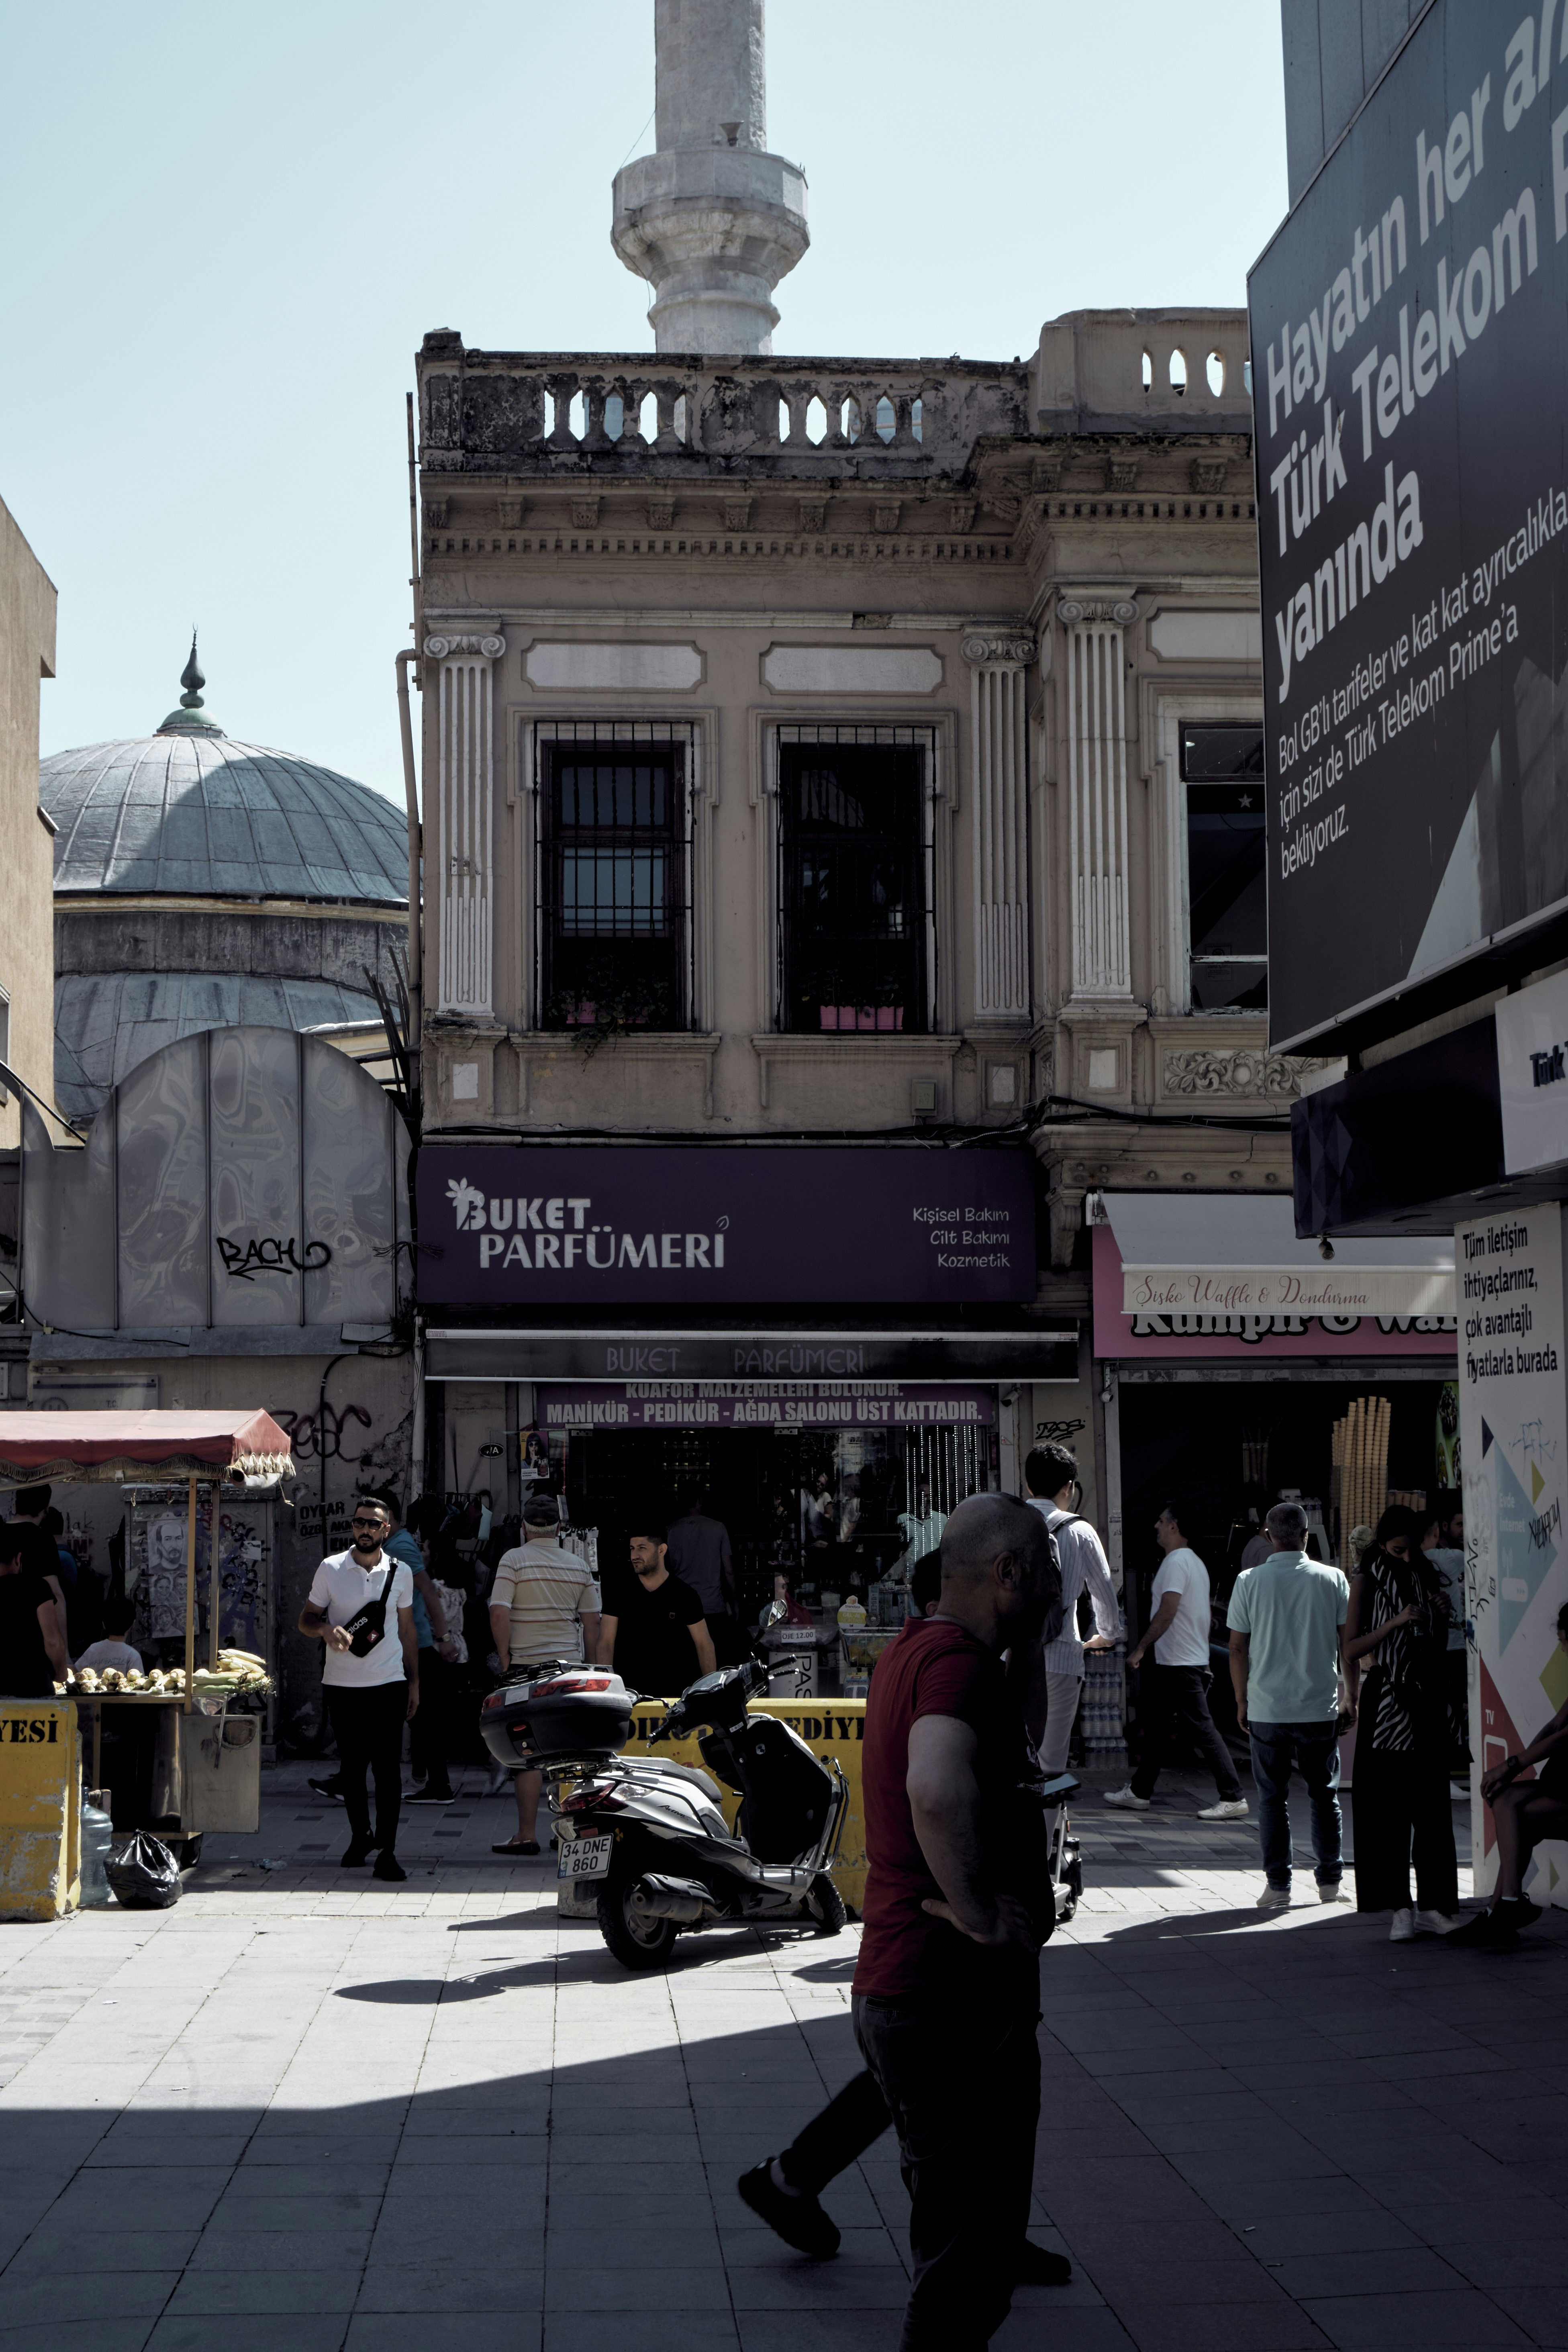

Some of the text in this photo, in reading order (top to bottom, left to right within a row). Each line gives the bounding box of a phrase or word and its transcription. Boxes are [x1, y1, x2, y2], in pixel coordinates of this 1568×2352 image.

[1267, 195, 1407, 438] Hayatın
[1416, 71, 1490, 247] her
[1270, 396, 1348, 557] Türk
[1352, 187, 1539, 463] Telekom
[1275, 460, 1424, 703] yanında
[1279, 722, 1298, 775] Bol
[1333, 653, 1387, 725] tarifeler
[1390, 634, 1408, 675] ve
[1412, 599, 1438, 657] kat
[1441, 572, 1469, 633] kat
[1280, 782, 1300, 833] için
[1303, 756, 1323, 808] sizi
[1325, 744, 1343, 788] de
[1345, 713, 1377, 771] Türk
[1378, 665, 1445, 744] Telekom
[1281, 804, 1349, 880] bekliyoruz.
[452, 1189, 591, 1230] BUKET
[913, 1207, 1009, 1224] Kişisel Bakım
[480, 1217, 728, 1268] PARFÜMERİ
[930, 1231, 1009, 1244] Cilt Bakımı
[1463, 1222, 1527, 1259] Tüm iletişim
[938, 1253, 1011, 1267] Kozmetik
[1188, 1275, 1253, 1309] Waffle
[1258, 1287, 1270, 1303] &
[1278, 1275, 1370, 1305] Dondurma
[1464, 1266, 1537, 1302] ihtiyaçlarınız,
[1466, 1303, 1532, 1345] çok avantajlı
[606, 1344, 864, 1374] BUKET PARFÜMERİ
[1517, 1343, 1558, 1374] burada
[547, 1401, 629, 1423] MANİKÜR
[644, 1400, 719, 1422] PEDİKÜR
[733, 1399, 781, 1421] AĞDA
[785, 1402, 852, 1421] SALONU
[856, 1399, 890, 1421] ÜST
[894, 1401, 982, 1420] KATTADIR.
[1499, 1492, 1515, 1508] Evde
[1485, 1709, 1494, 1725] TV
[563, 1838, 610, 1858] 34 DNE
[572, 1856, 598, 1872] 860
